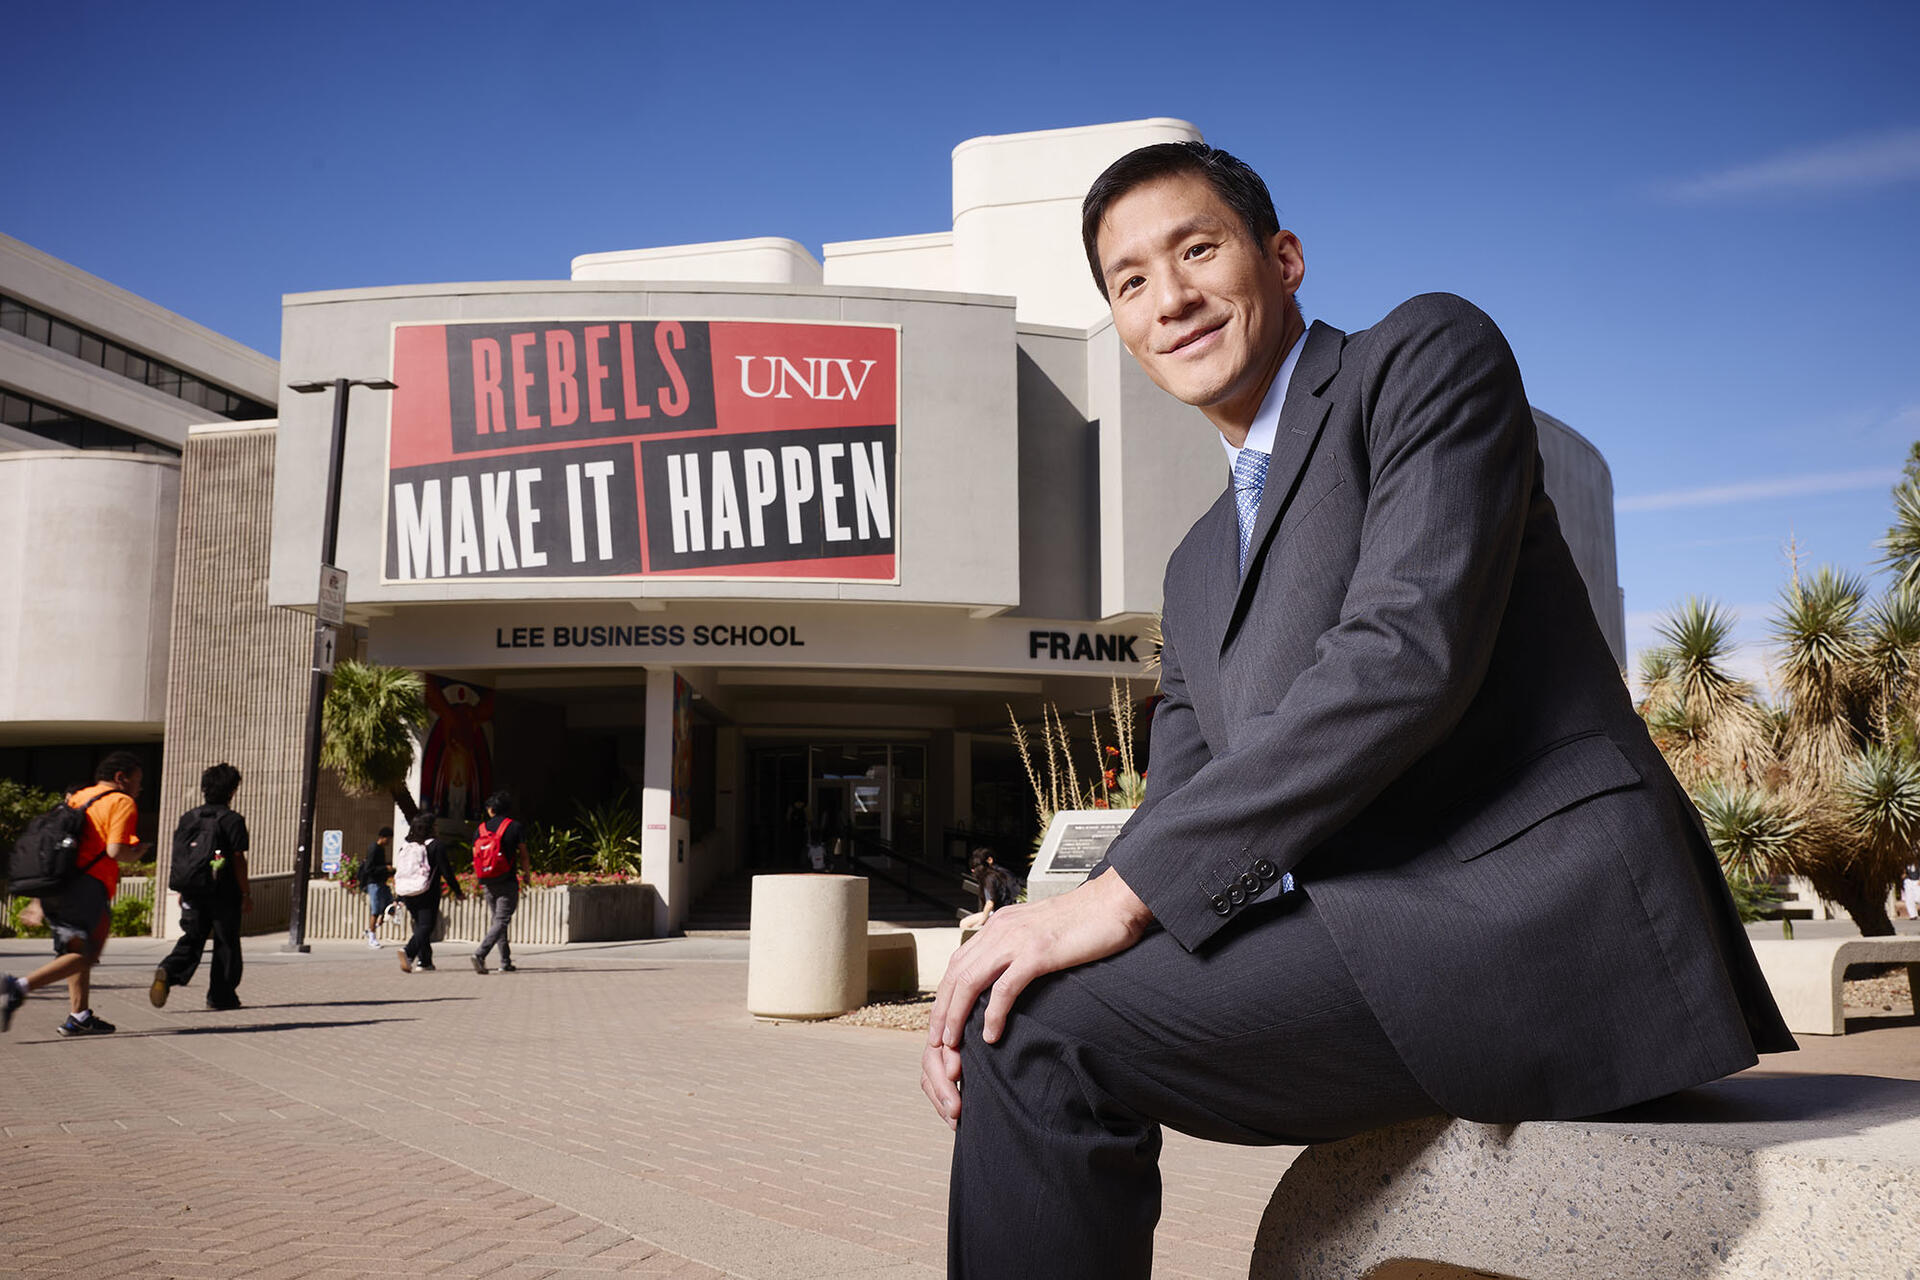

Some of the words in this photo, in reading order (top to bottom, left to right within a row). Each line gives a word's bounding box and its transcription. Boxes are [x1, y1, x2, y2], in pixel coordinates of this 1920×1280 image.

[471, 321, 690, 435] REBELS
[735, 355, 877, 400] UNLV
[394, 468, 547, 580] MAKE
[566, 461, 614, 563] IT
[667, 441, 891, 553] HAPPEN
[496, 627, 545, 648] LEE
[553, 625, 685, 647] BUSINESS
[693, 625, 805, 646] SCHOOL
[1029, 630, 1140, 663] FRANK
